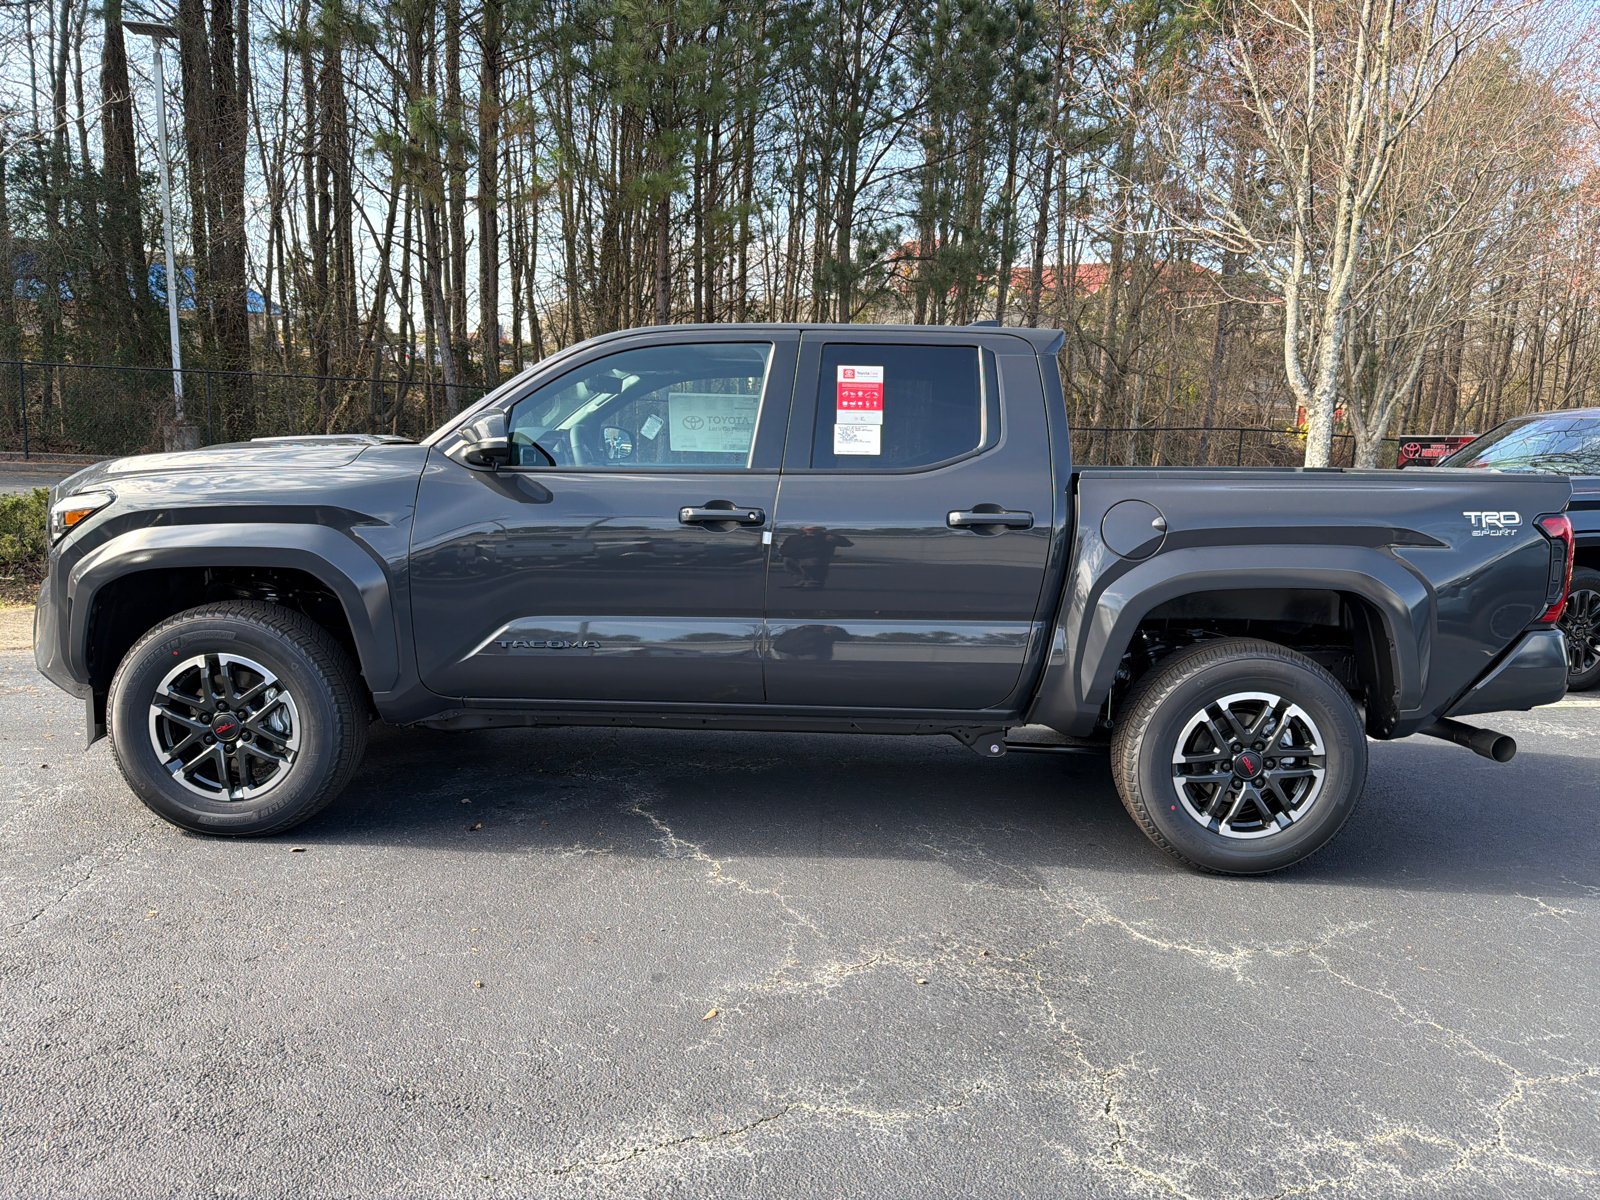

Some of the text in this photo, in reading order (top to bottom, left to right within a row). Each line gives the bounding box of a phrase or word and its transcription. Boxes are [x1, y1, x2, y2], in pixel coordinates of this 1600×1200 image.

[706, 415, 750, 425] TOYOTA
[1462, 511, 1523, 528] TRD
[1471, 529, 1518, 537] SPORT
[495, 640, 600, 649] TACOMA
[216, 722, 236, 734] TRD
[1241, 756, 1255, 775] TRD
